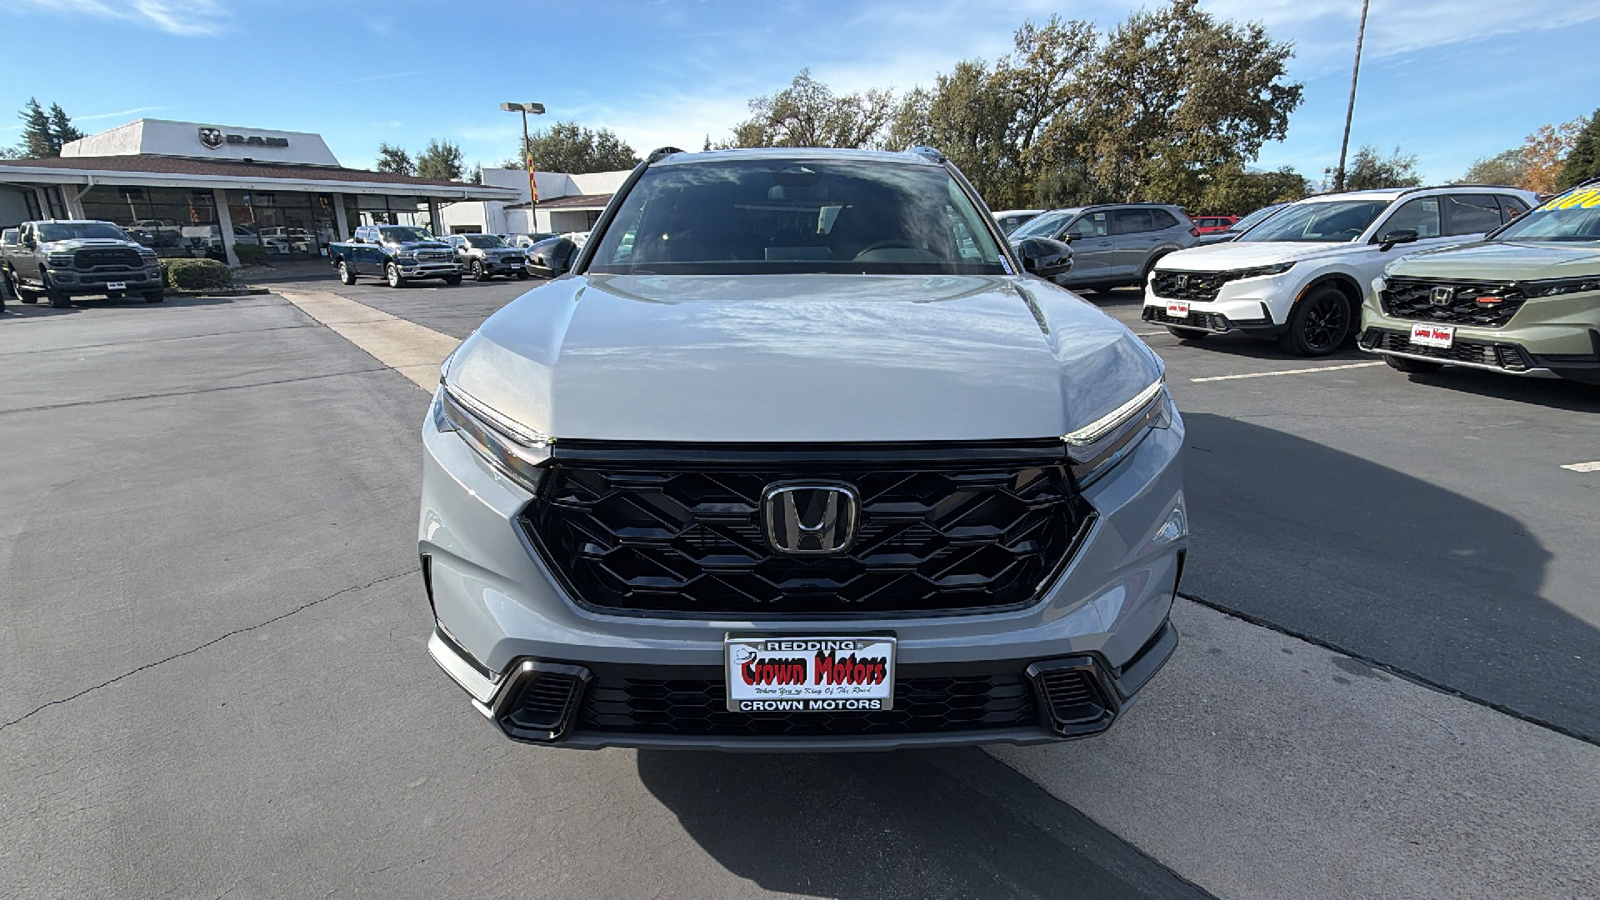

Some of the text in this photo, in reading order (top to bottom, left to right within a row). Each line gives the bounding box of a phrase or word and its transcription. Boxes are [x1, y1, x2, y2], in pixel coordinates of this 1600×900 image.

[767, 641, 855, 650] REDDING
[741, 650, 888, 686] Crown Motors
[804, 687, 822, 695] King
[824, 687, 834, 696] Of
[836, 686, 849, 694] The
[851, 686, 872, 694] Road
[740, 700, 881, 711] CROWN MOTORS
